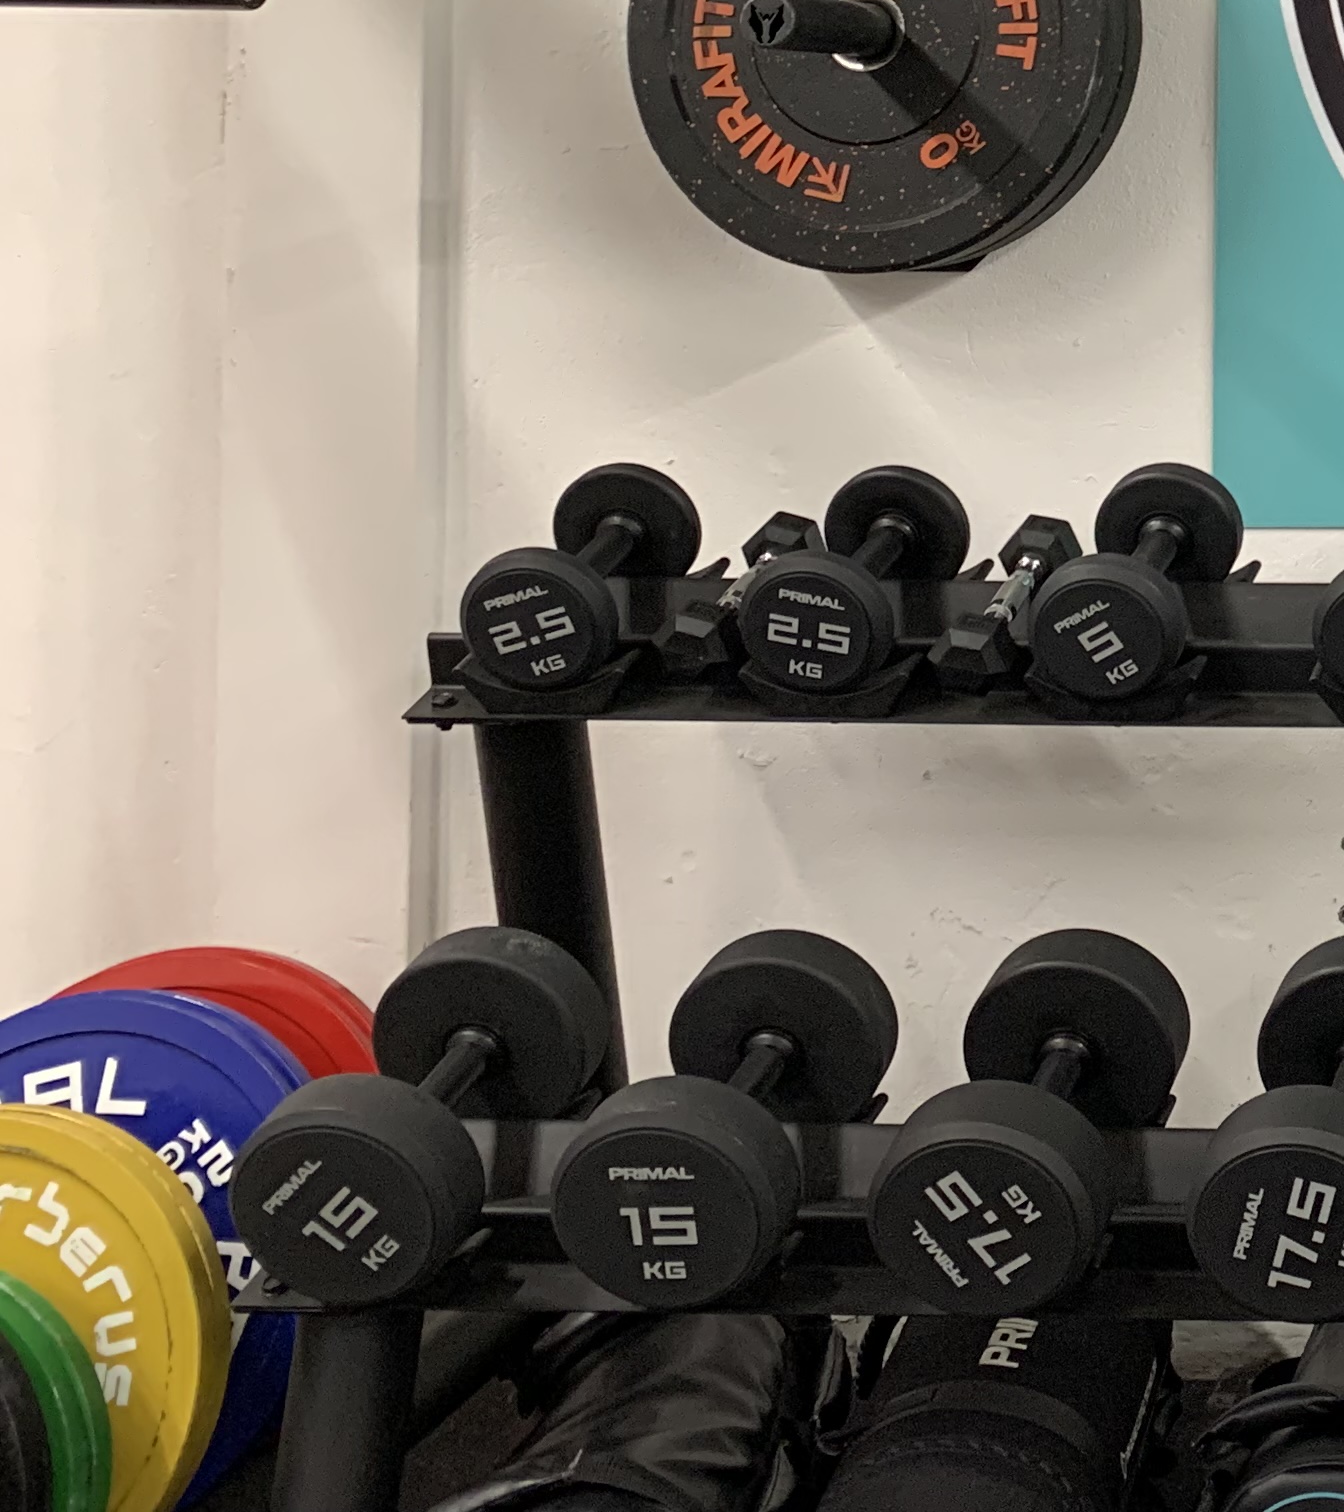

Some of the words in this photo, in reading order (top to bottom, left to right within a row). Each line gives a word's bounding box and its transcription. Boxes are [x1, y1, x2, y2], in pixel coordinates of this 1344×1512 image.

[955, 120, 987, 155] KG
[484, 586, 548, 611] PRIMAL
[779, 588, 845, 610] PRIMAL
[1054, 601, 1109, 633] PRIMAL
[488, 606, 575, 654] 2.5
[768, 613, 850, 654] 2.5
[1078, 622, 1123, 662] 5
[531, 654, 566, 676] KG
[789, 659, 822, 678] KG
[1106, 659, 1138, 684] KG
[0, 1057, 147, 1116] AL
[262, 1161, 322, 1215] PRIMAL
[609, 1167, 694, 1180] PRIMAL
[302, 1187, 378, 1251] 15
[1002, 1185, 1041, 1223] KG
[620, 1207, 698, 1245] 15
[925, 1171, 1031, 1284] 17.5
[1233, 1188, 1264, 1259] PRIMAL
[1268, 1177, 1336, 1288] 17.5
[362, 1237, 399, 1271] KG
[643, 1261, 686, 1279] KG
[914, 1220, 969, 1287] PRIMAL
[979, 1318, 1038, 1368] PRI
